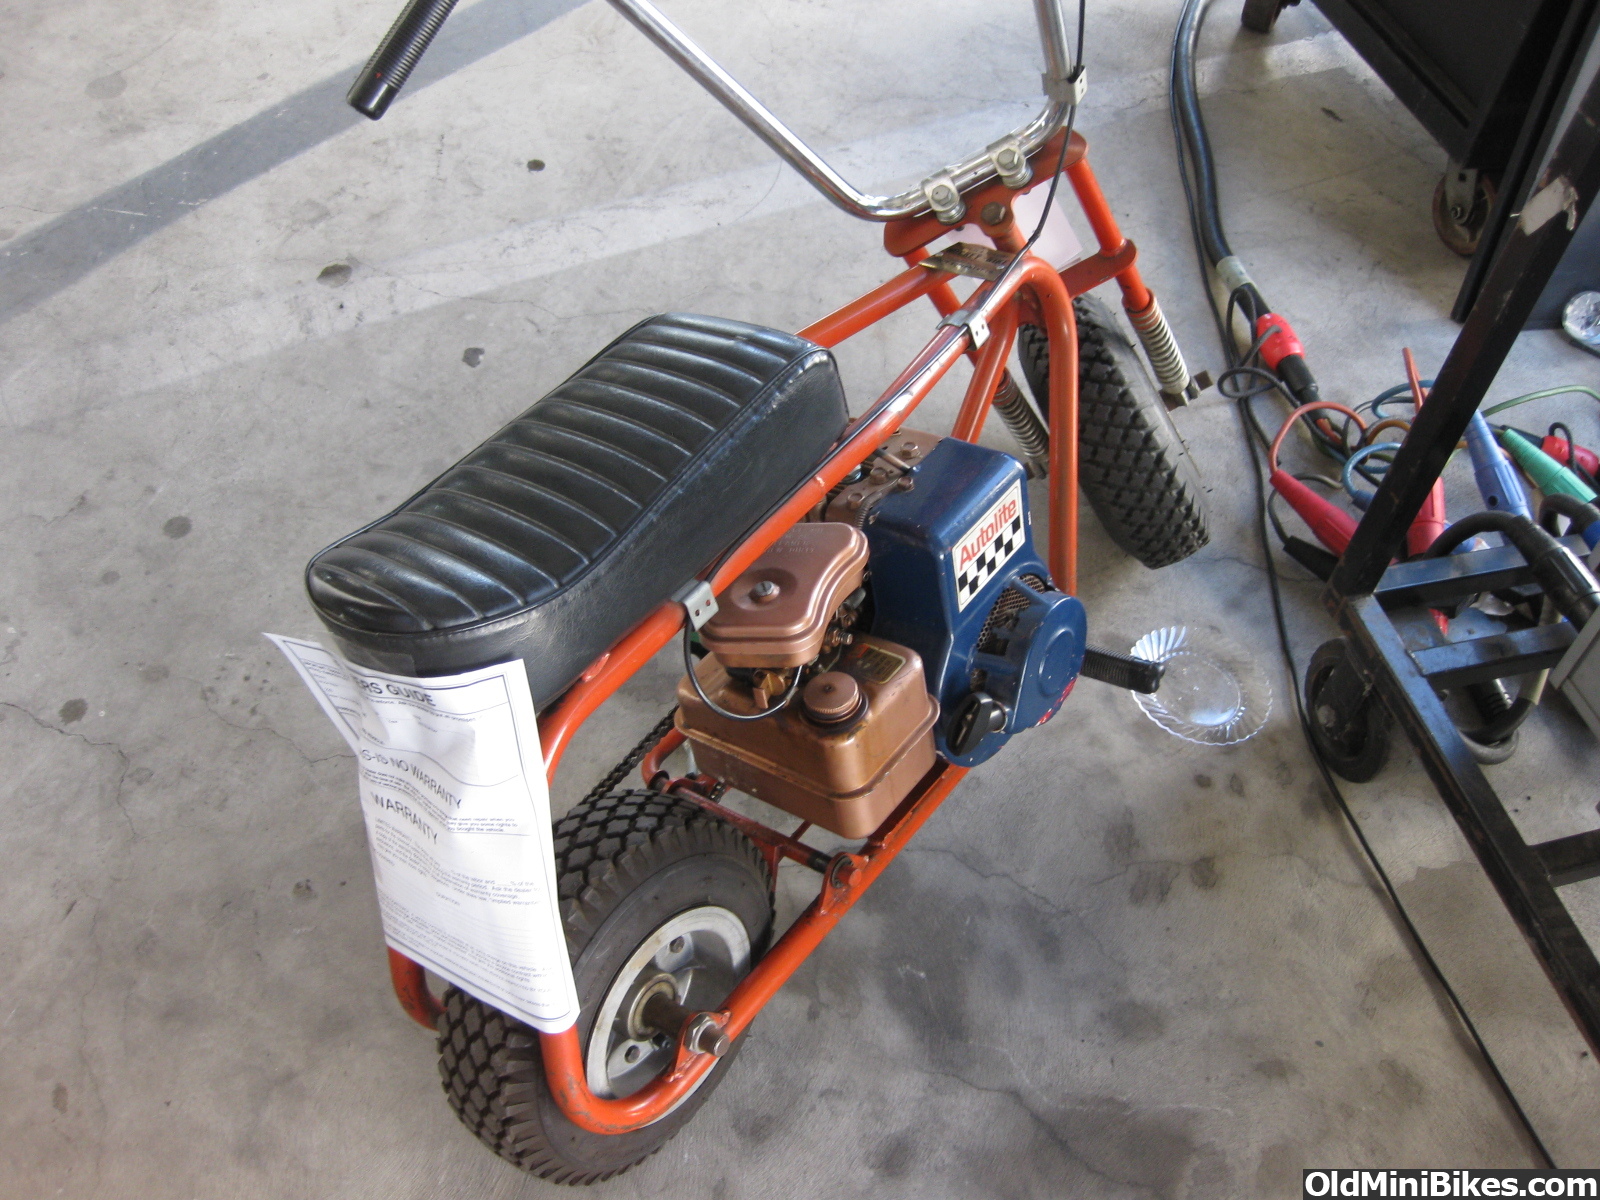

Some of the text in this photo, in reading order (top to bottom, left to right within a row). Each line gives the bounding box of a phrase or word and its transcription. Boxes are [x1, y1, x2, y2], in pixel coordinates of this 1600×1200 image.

[960, 499, 1017, 571] Autolite
[386, 683, 436, 707] GUIDE
[389, 756, 409, 772] NO
[410, 764, 462, 809] WARRANTY
[370, 791, 438, 845] WARRANTY
